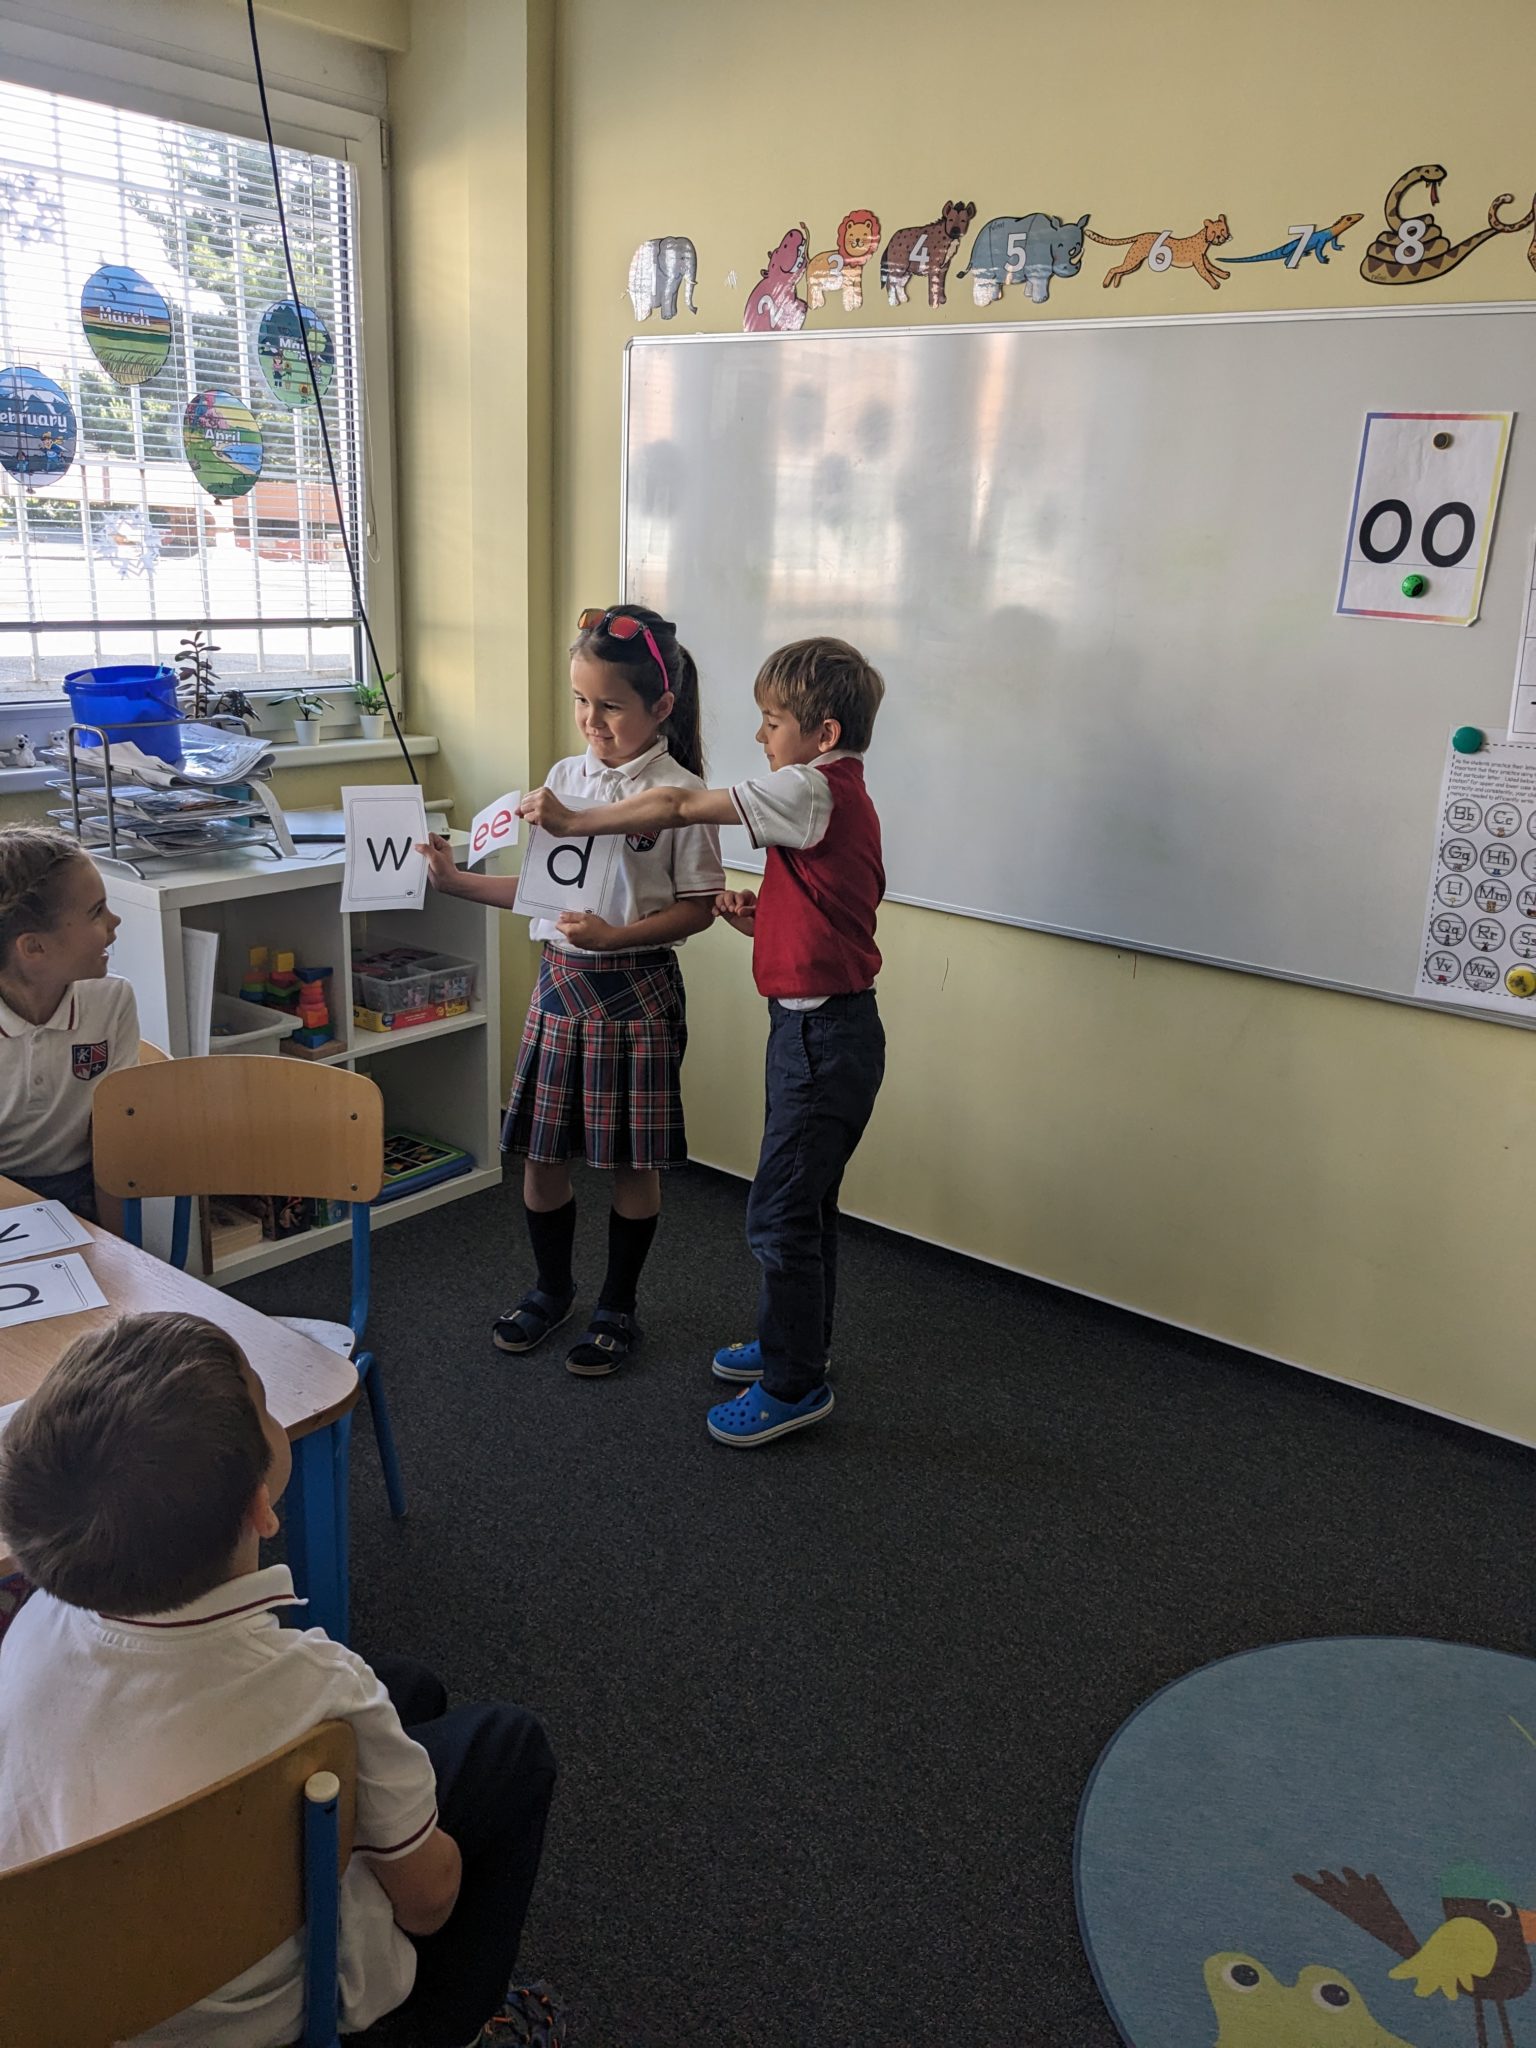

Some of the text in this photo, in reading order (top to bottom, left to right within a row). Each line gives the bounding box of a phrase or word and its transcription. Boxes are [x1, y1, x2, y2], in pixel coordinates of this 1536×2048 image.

[909, 234, 930, 271] 4
[1004, 233, 1027, 272] 5
[1149, 230, 1173, 272] 6
[1286, 224, 1316, 268] 7
[1394, 219, 1427, 264] 8
[828, 253, 844, 277] 3
[99, 305, 151, 327] March
[758, 294, 783, 329] 2
[0, 407, 67, 433] ebruary
[205, 428, 241, 448] April
[1454, 806, 1513, 825] Bb Cc
[473, 809, 511, 852] ee
[547, 836, 593, 889] d
[1449, 846, 1510, 866] Gg Hh
[1480, 886, 1507, 901] Mm
[1438, 920, 1461, 941] Qq
[1478, 925, 1497, 940] Rr
[1436, 957, 1495, 978] Vv Ww
